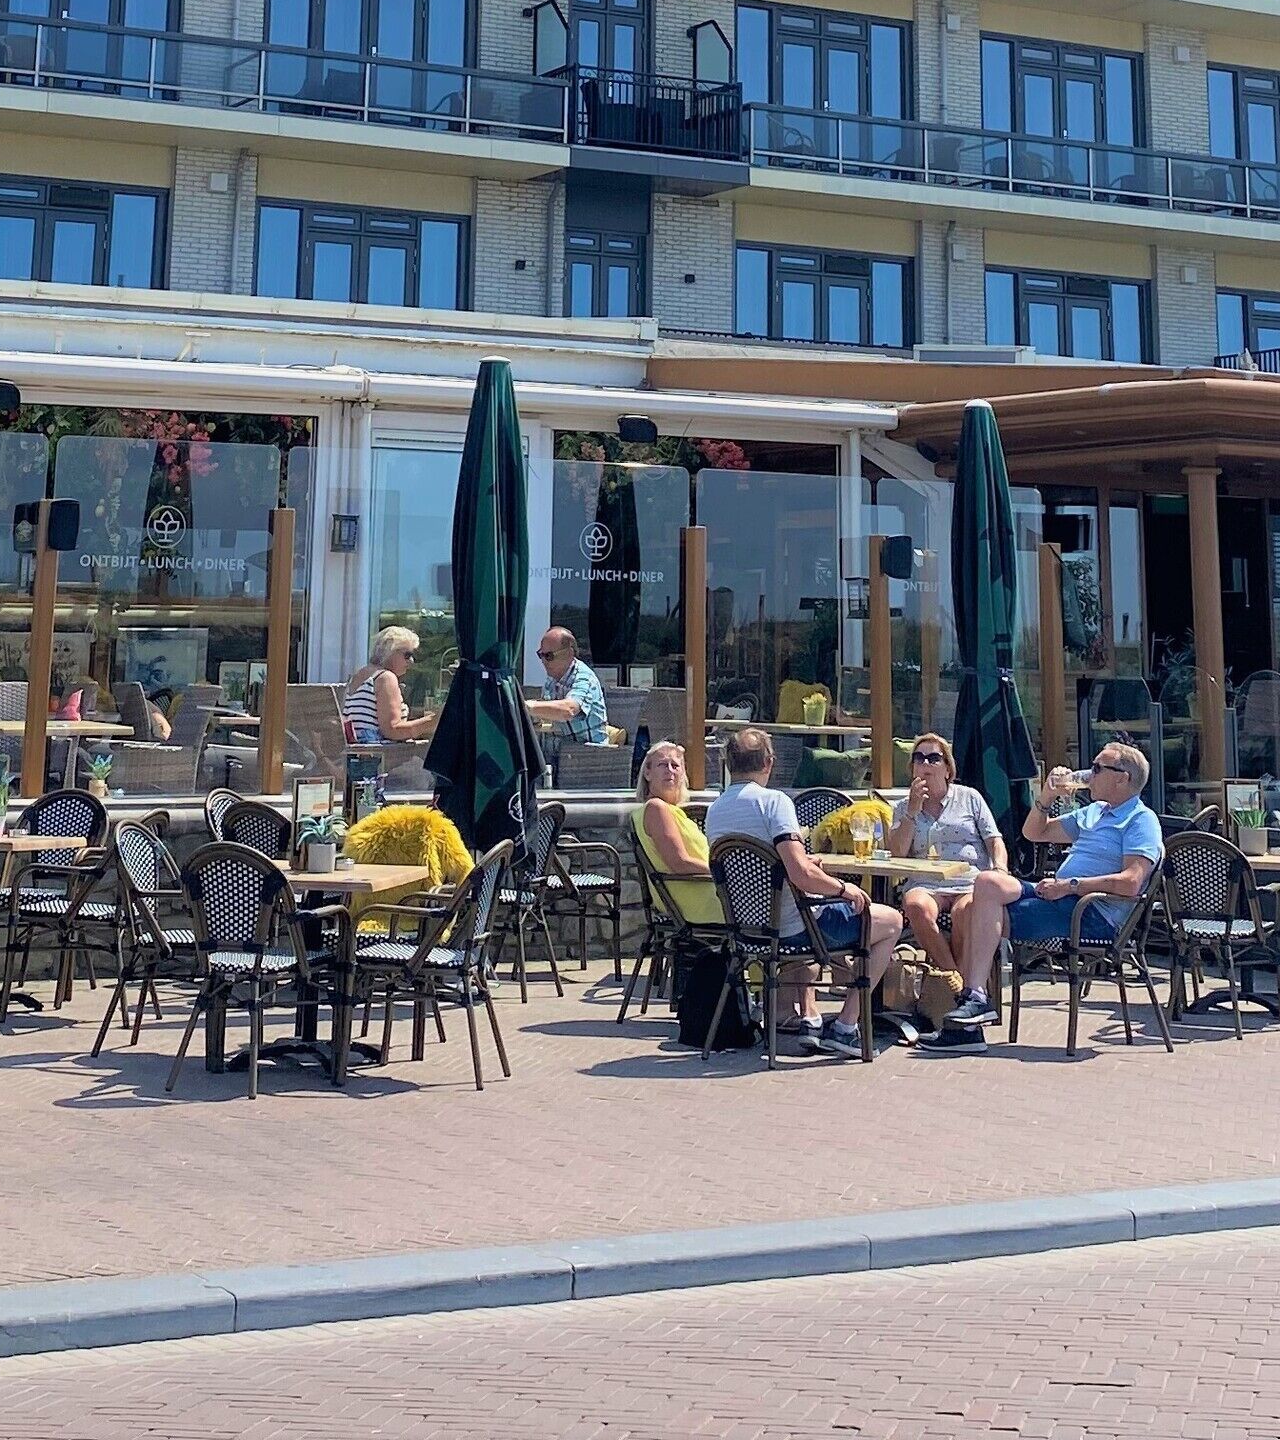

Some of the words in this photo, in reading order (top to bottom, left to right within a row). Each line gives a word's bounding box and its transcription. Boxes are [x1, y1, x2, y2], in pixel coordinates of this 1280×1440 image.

[79, 553, 138, 569] ONTBIJT
[147, 555, 195, 571] LUNCH
[204, 558, 246, 571] DINER
[581, 567, 622, 582] LUNCH
[628, 570, 665, 583] DINER
